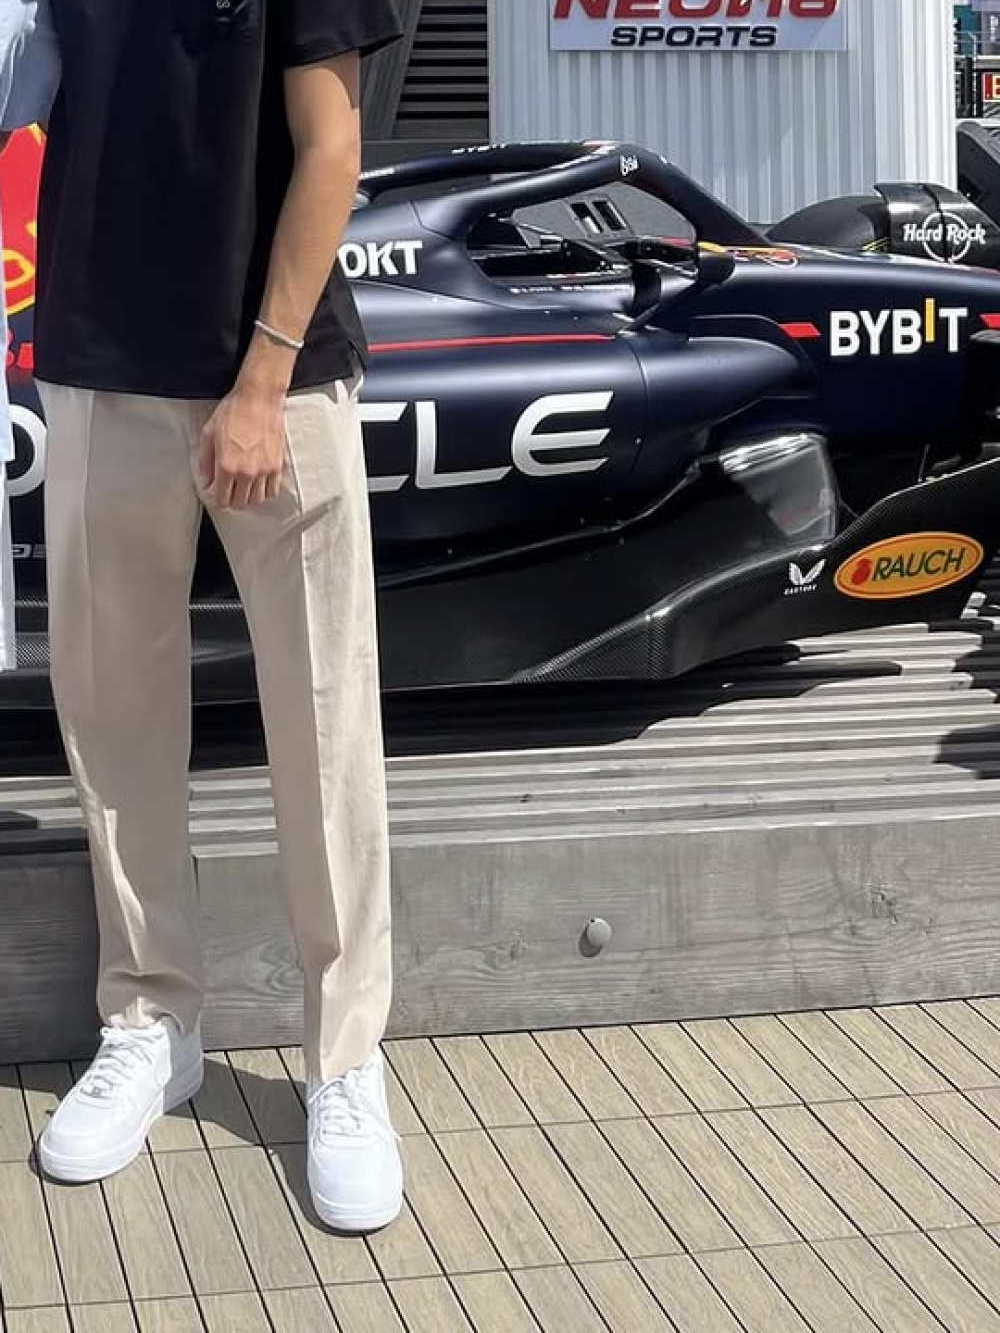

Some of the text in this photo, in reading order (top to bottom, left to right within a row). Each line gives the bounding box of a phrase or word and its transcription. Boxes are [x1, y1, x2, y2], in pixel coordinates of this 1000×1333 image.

[610, 25, 777, 48] SPORTS
[903, 223, 987, 246] Hard Rock
[830, 297, 969, 357] BYBIT
[872, 547, 966, 583] RAUCH
